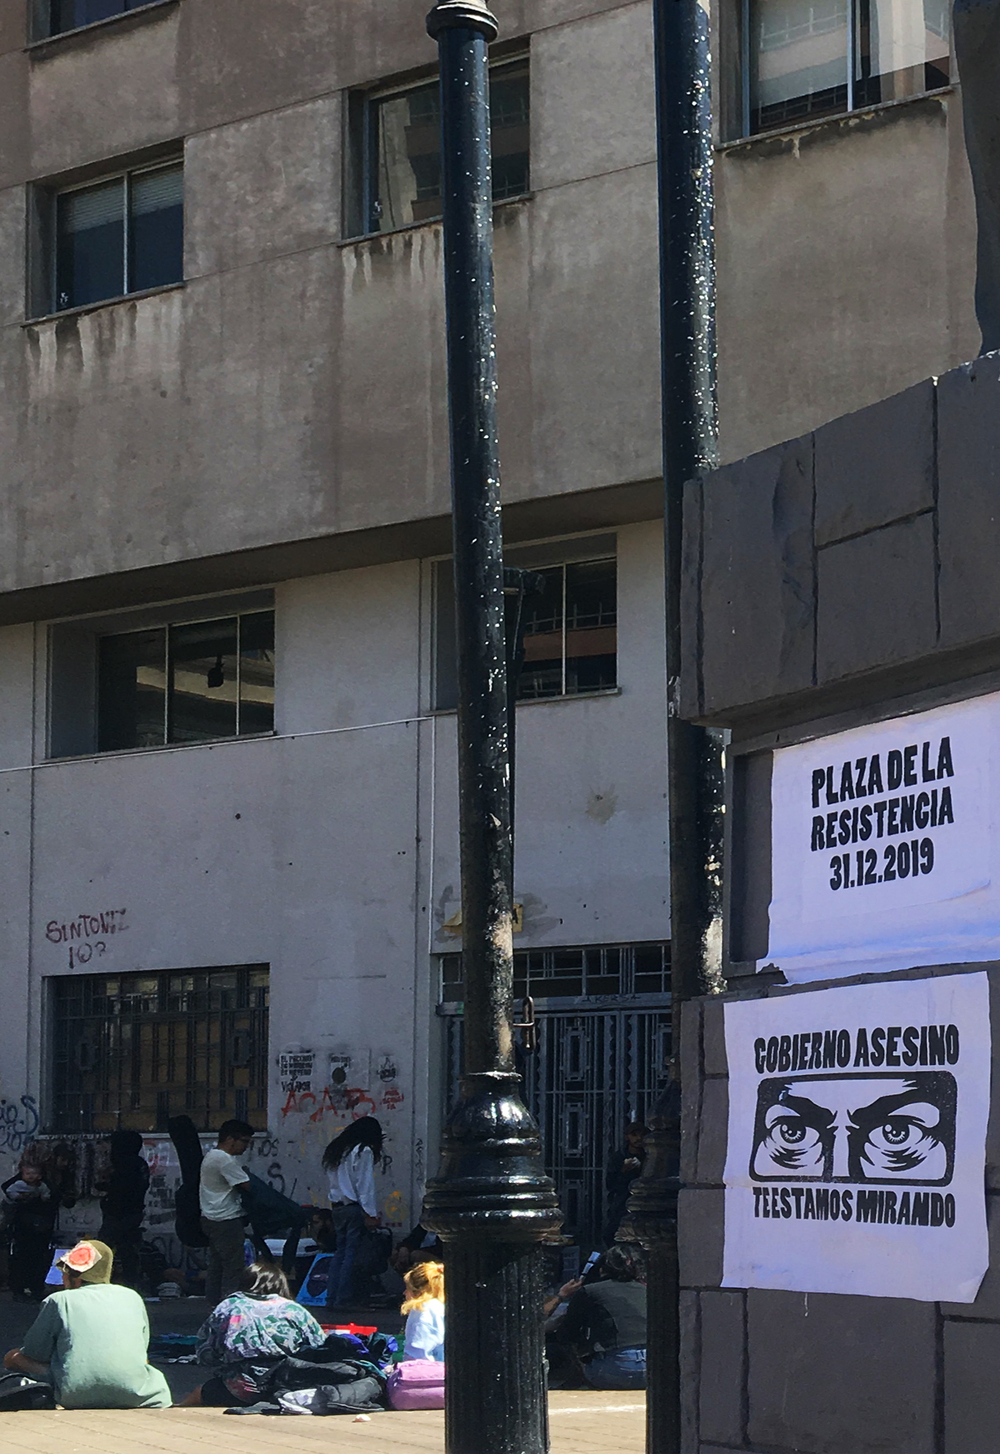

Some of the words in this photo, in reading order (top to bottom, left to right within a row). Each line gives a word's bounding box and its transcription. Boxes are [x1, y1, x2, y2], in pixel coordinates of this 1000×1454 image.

[811, 753, 884, 808] PLAZA
[887, 744, 918, 791] DE
[922, 736, 954, 783] LA
[811, 786, 954, 851] RESISTENCIA
[829, 837, 934, 891] 31.12.2019
[754, 1029, 850, 1074] GOBIERNO
[853, 1024, 959, 1067] ASESINO
[856, 1190, 956, 1228] MIRANDO
